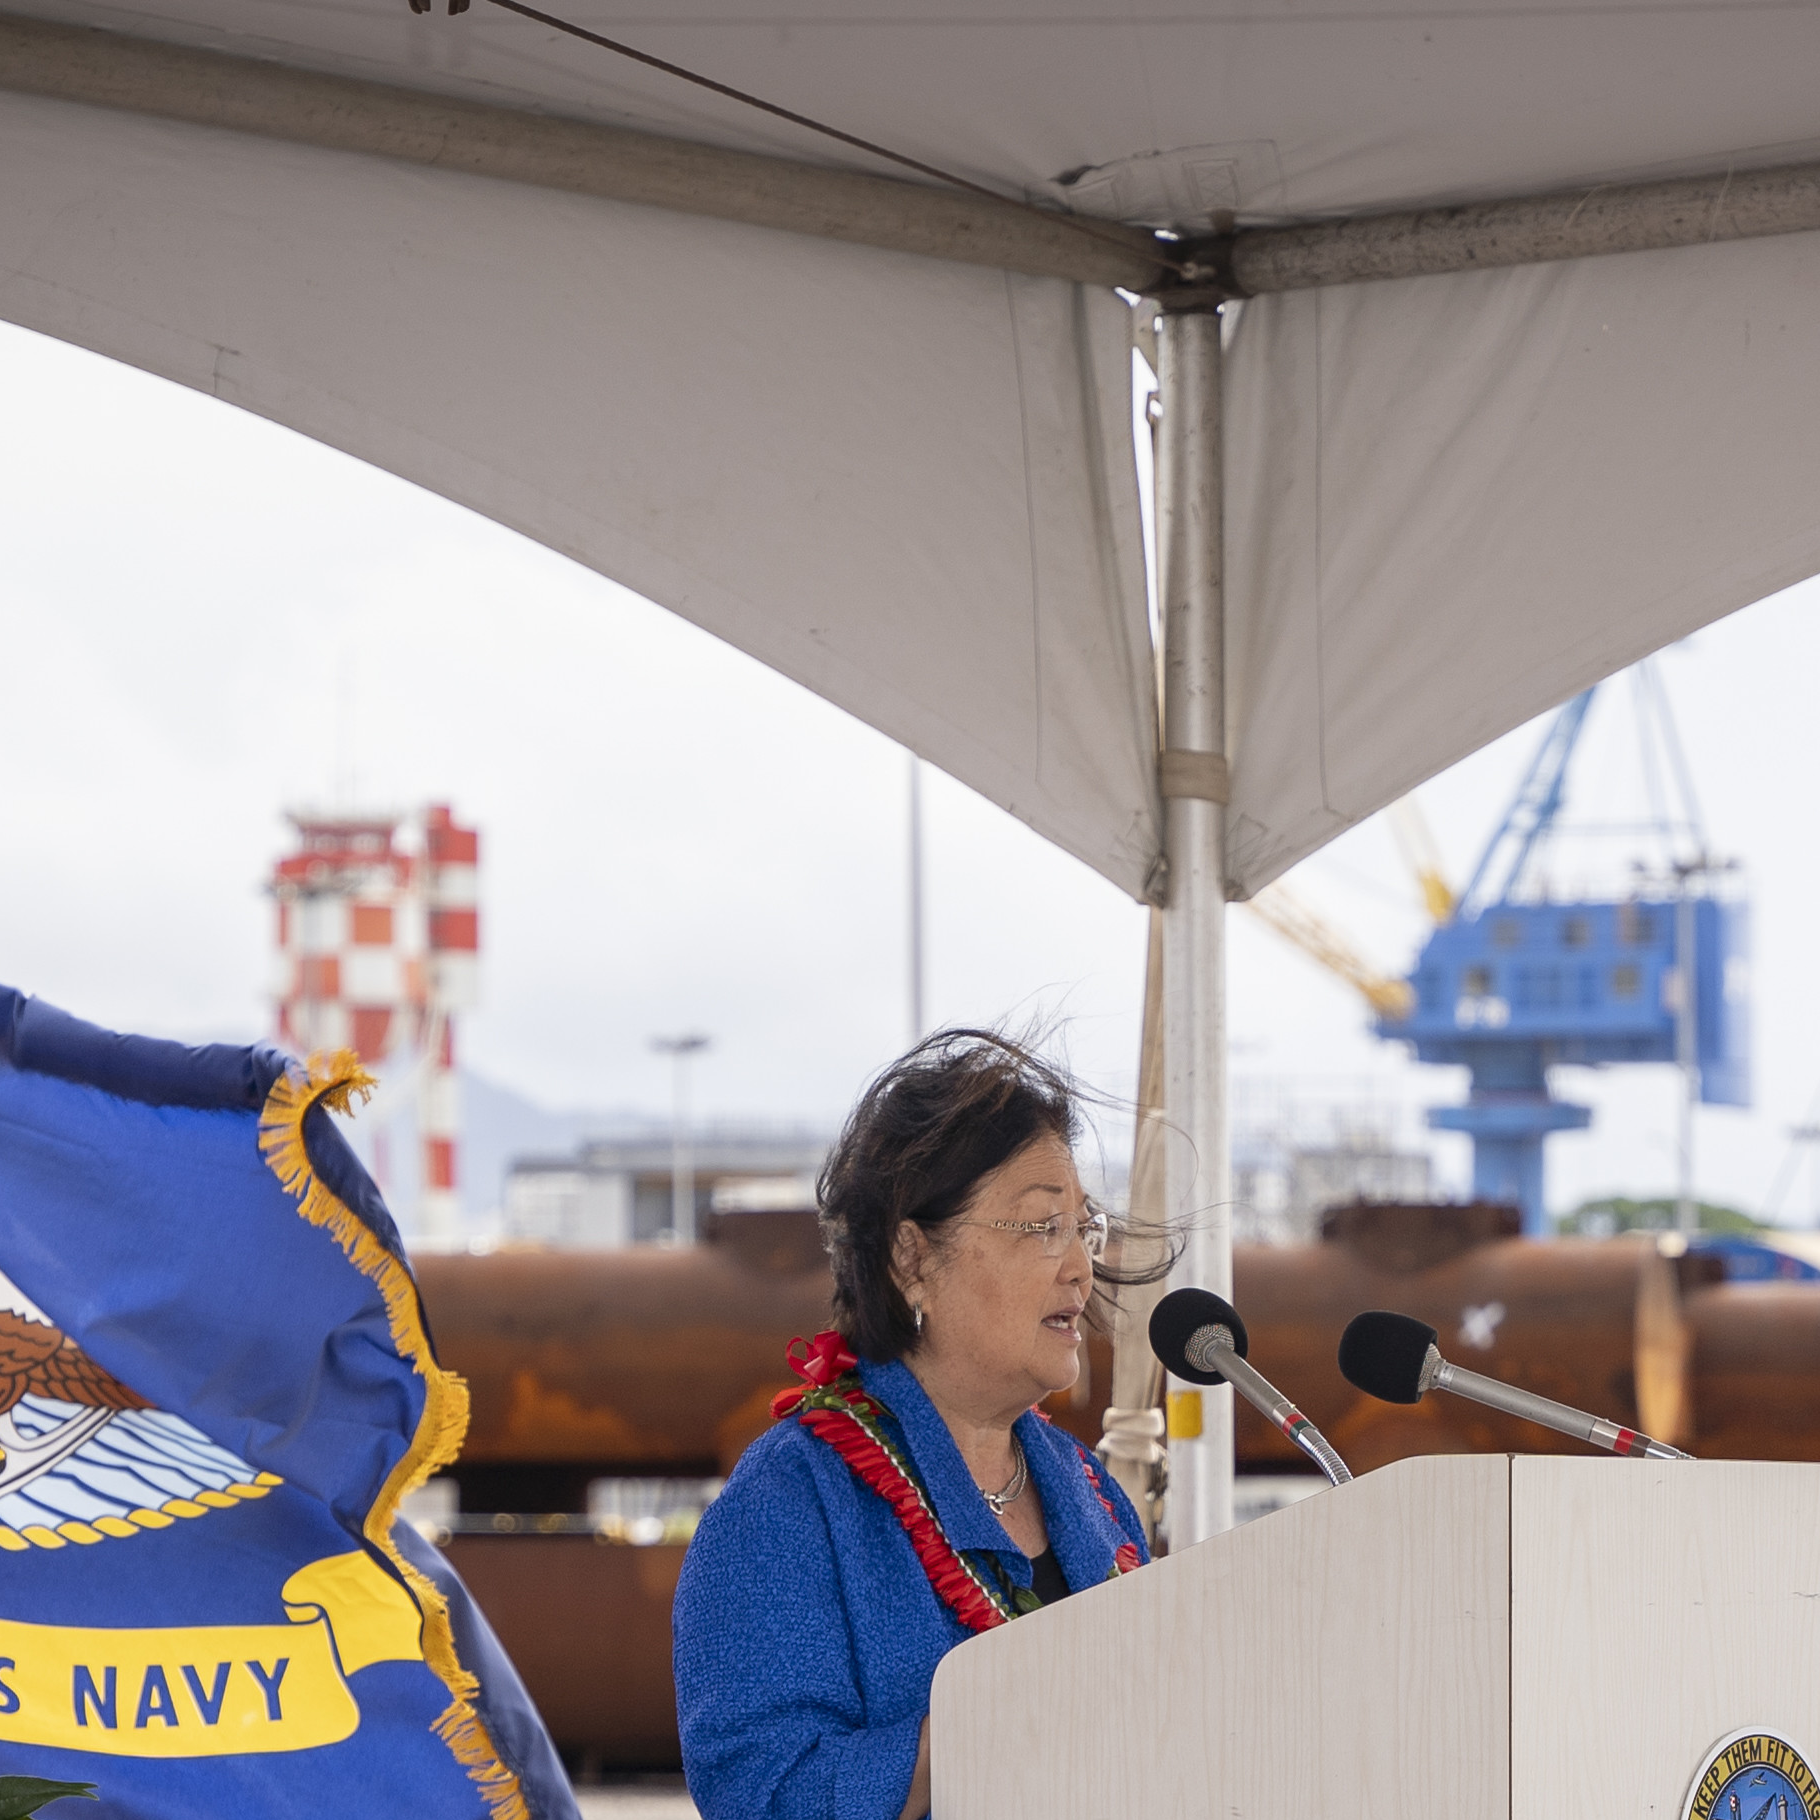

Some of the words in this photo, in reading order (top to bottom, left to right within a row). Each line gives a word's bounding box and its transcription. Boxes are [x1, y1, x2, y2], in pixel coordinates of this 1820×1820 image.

[72, 1656, 292, 1731] NAVY
[1693, 1766, 1722, 1819] KEEP
[1722, 1738, 1762, 1774] THEM
[1767, 1739, 1790, 1768] FIT
[1787, 1753, 1806, 1784] TO
